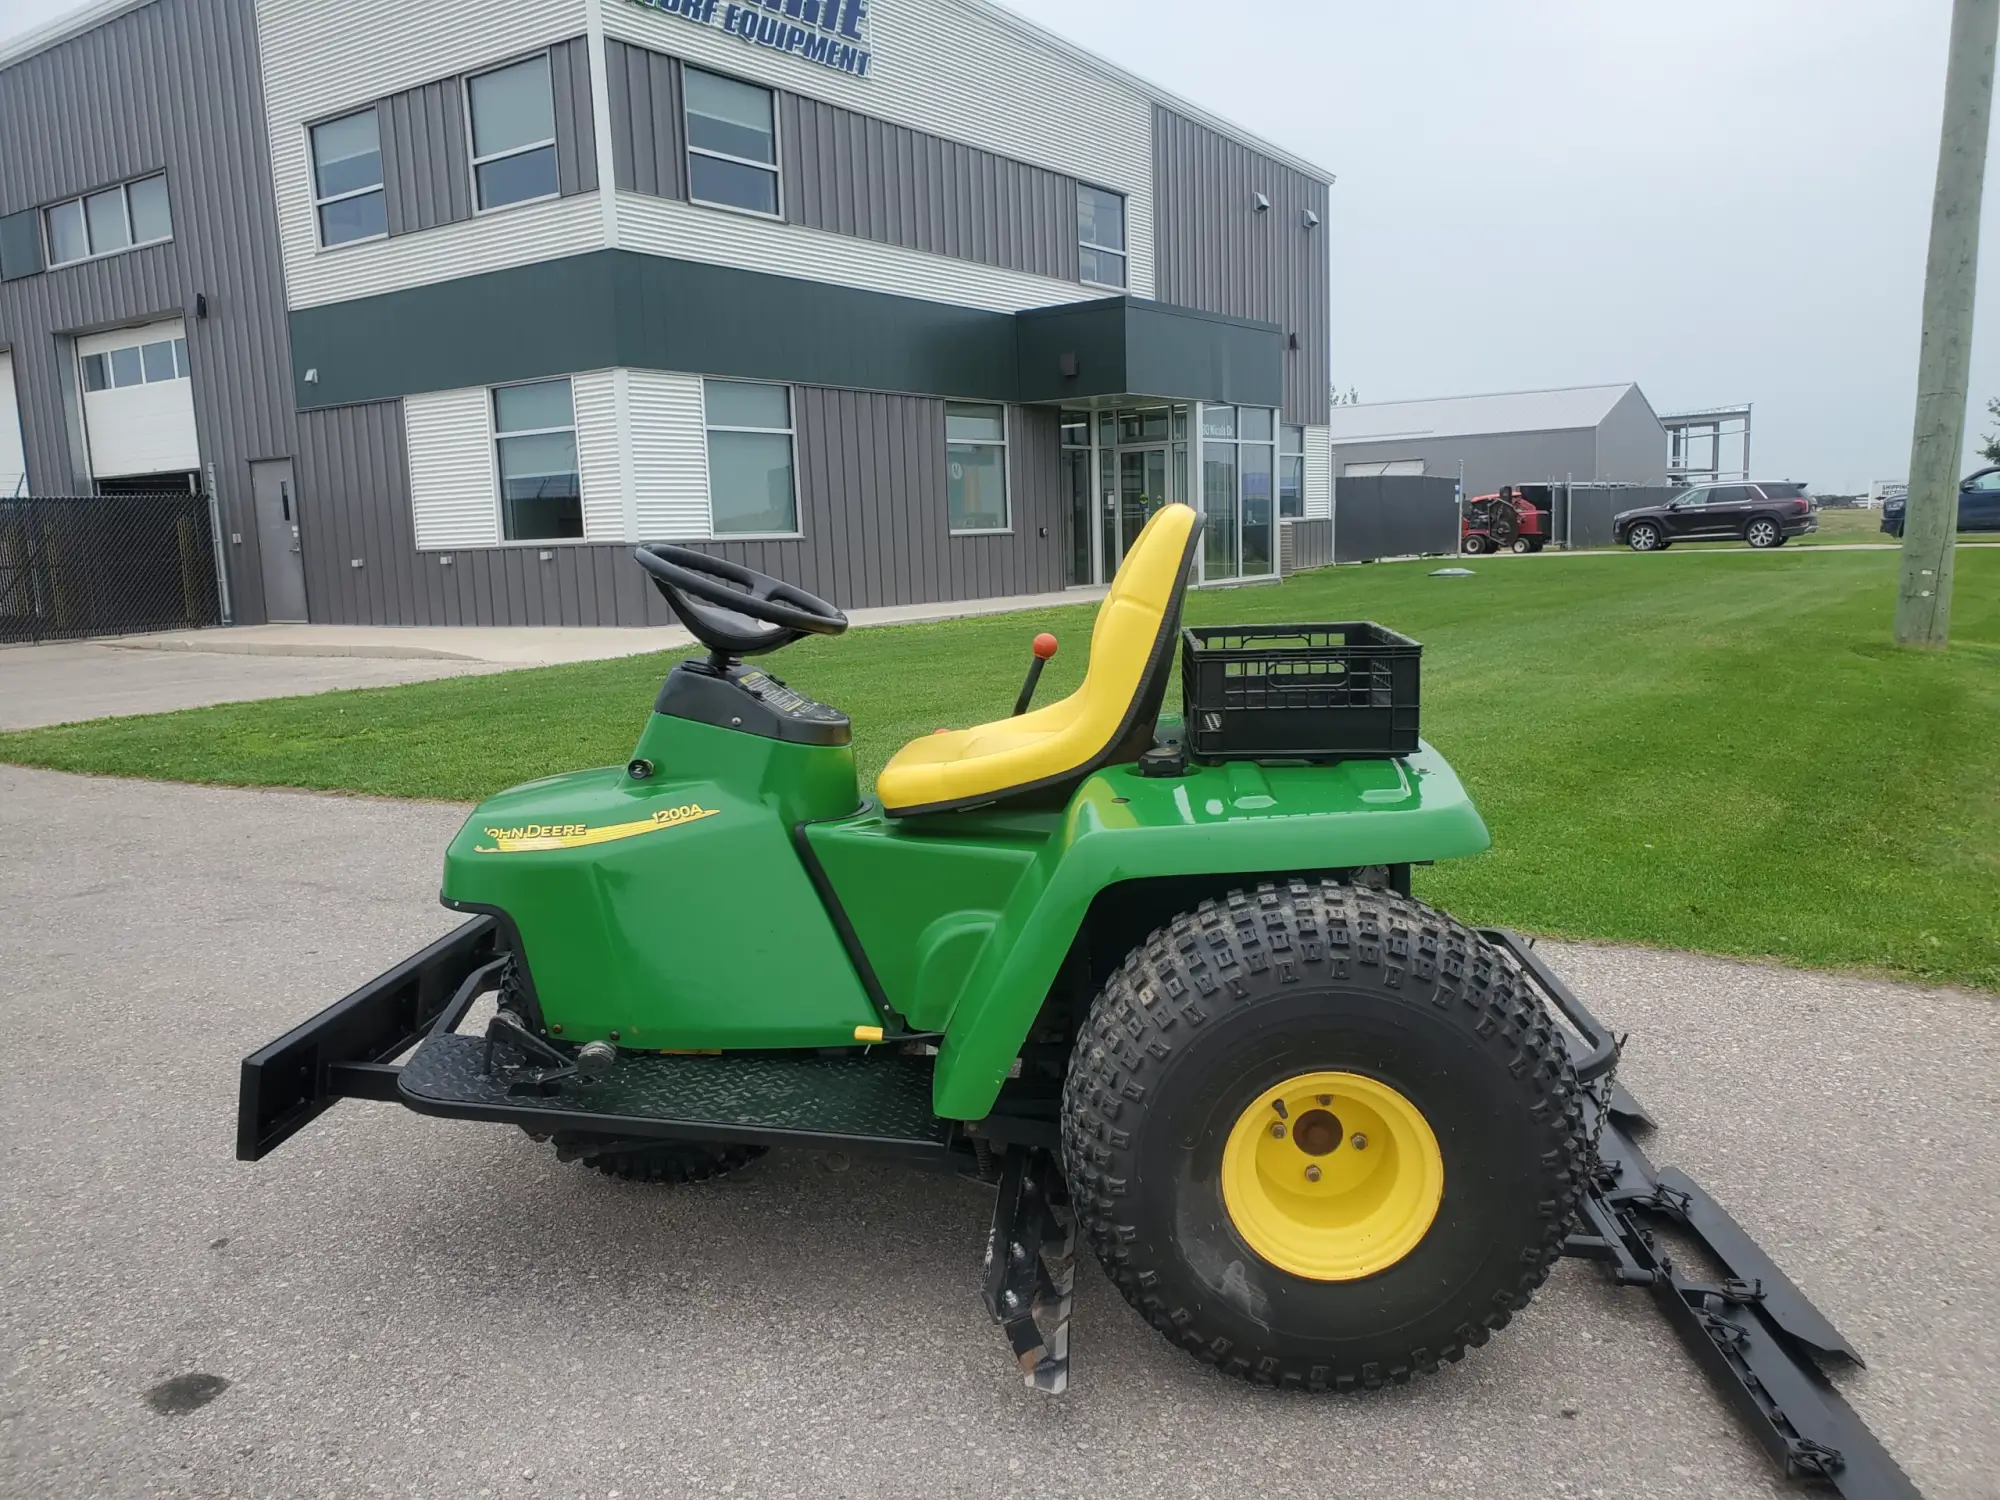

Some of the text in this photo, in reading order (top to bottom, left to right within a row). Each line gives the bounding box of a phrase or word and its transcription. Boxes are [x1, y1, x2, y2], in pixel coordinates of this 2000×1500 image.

[724, 3, 872, 76] EQUIPMENT
[652, 803, 704, 823] 1200A
[484, 824, 587, 840] OHN DEERE
